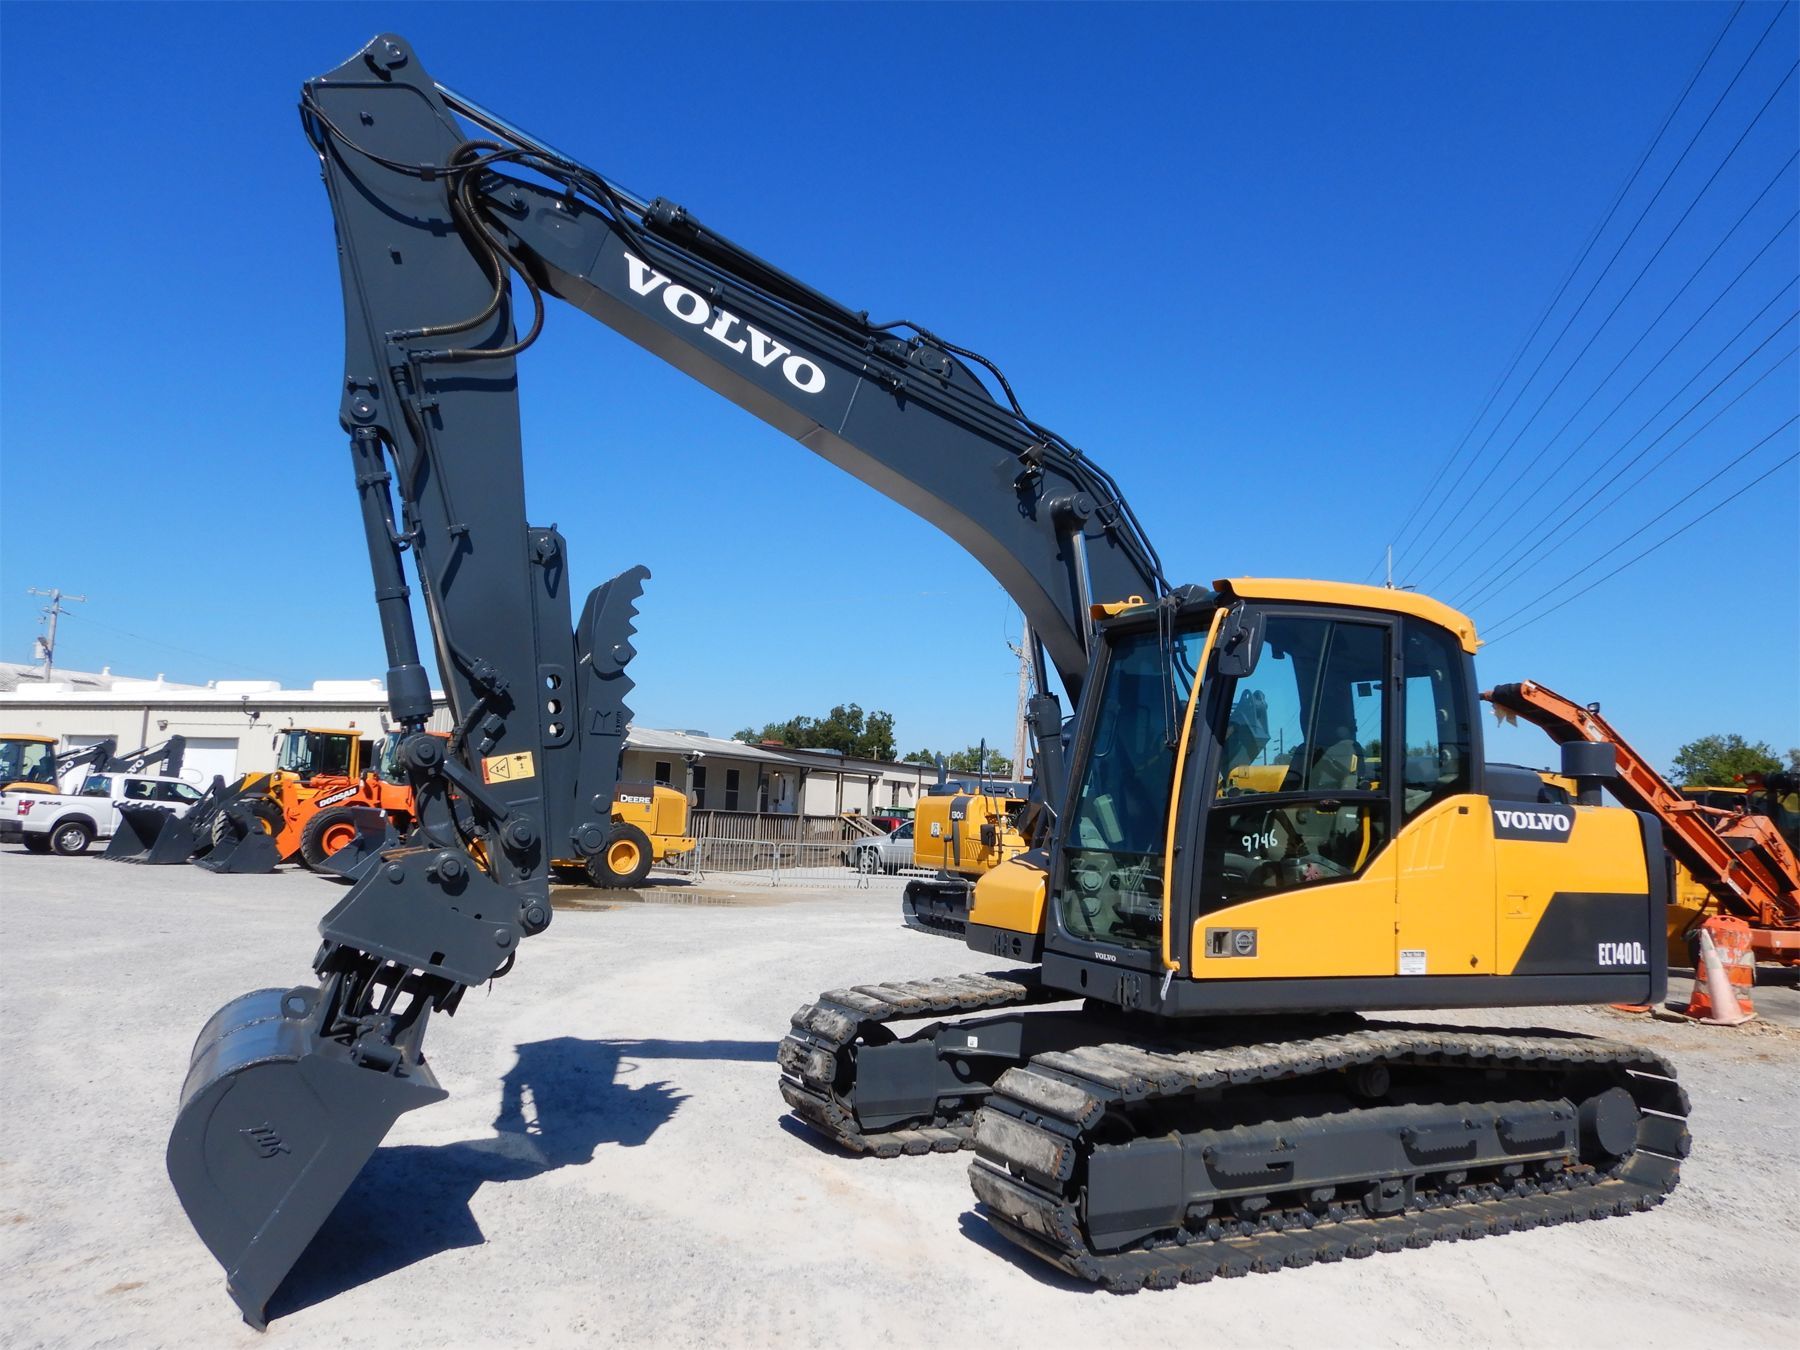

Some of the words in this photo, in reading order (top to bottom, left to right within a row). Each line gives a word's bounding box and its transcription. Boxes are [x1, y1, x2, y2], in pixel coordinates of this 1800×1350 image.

[624, 252, 826, 393] VOLVO
[319, 787, 357, 807] DOOSAN
[620, 794, 651, 804] DEERE
[1494, 810, 1570, 832] VOLVO
[1242, 829, 1278, 852] 9746
[1094, 951, 1117, 962] VOLVO
